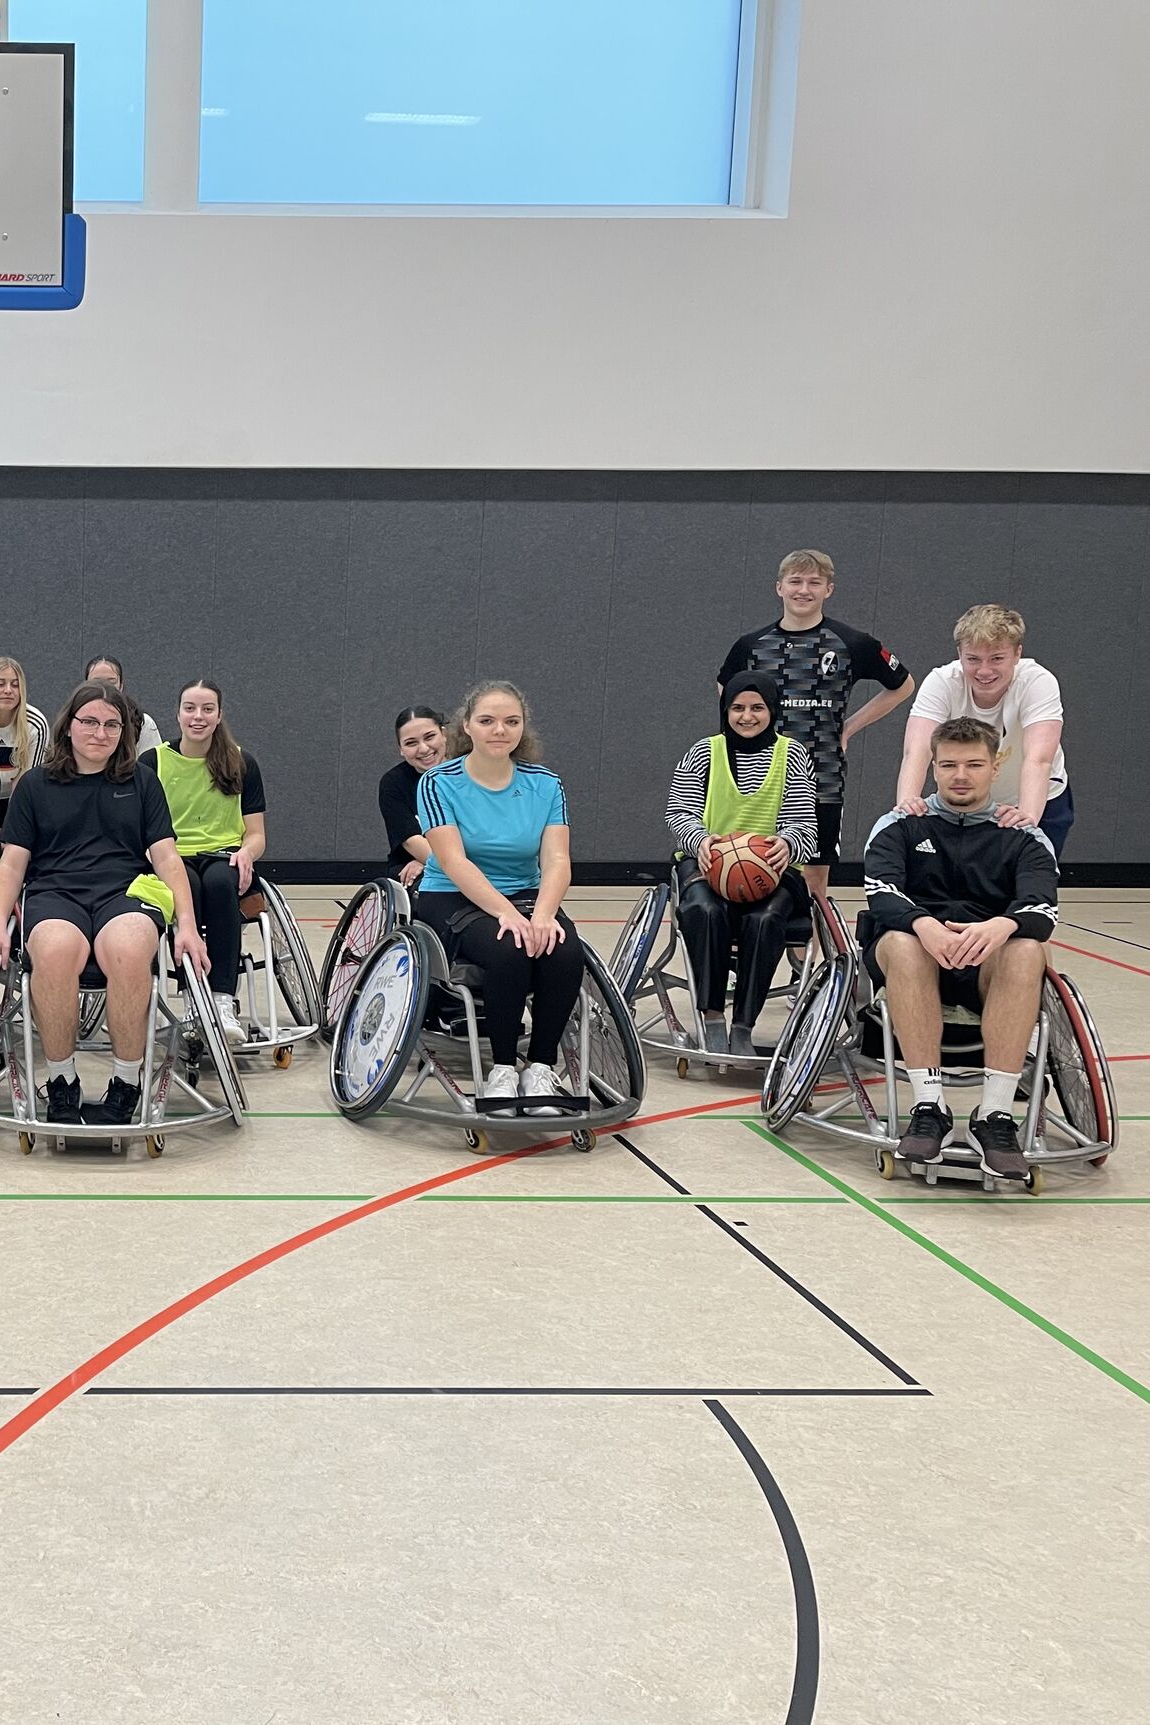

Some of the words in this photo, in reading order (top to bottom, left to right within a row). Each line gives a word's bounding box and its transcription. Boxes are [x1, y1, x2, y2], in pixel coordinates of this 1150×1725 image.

[25, 273, 55, 282] SPORT
[373, 974, 397, 990] RWE
[368, 1012, 396, 1062] RWE
